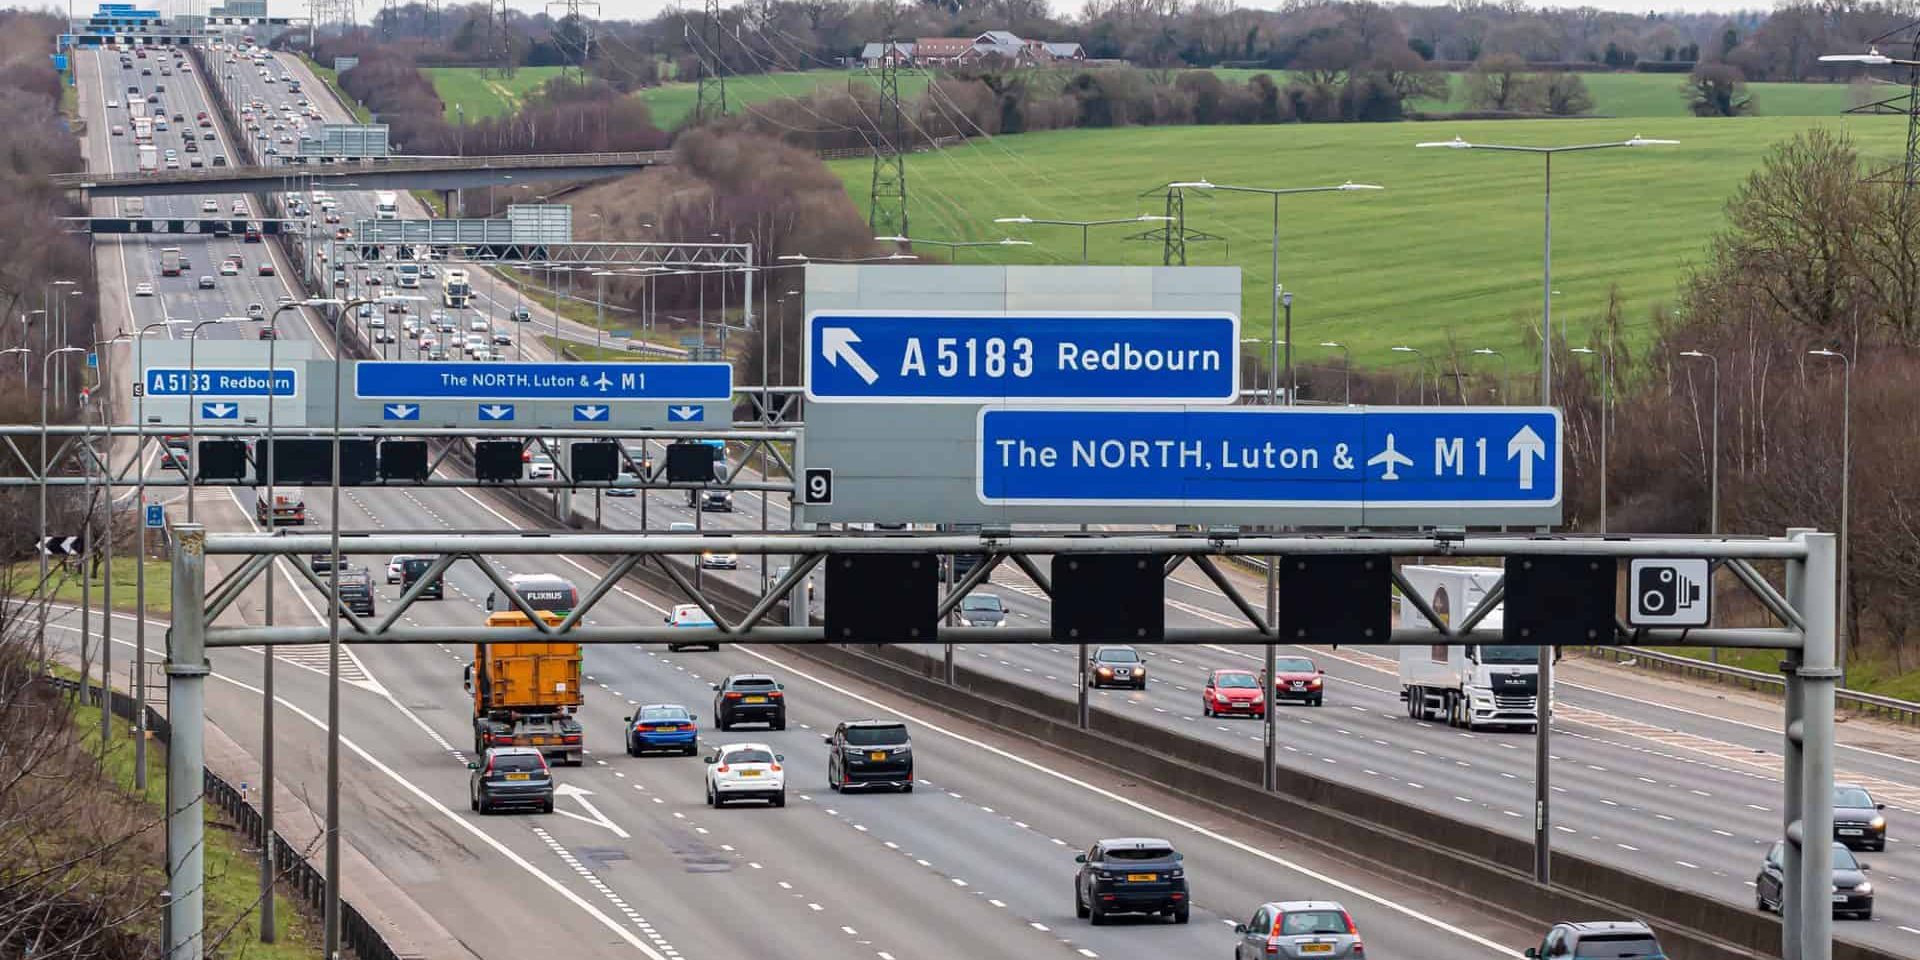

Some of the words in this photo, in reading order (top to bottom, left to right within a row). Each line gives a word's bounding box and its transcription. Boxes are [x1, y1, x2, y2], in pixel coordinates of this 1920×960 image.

[900, 337, 1033, 378] A5183
[1058, 342, 1220, 371] Redbourn
[220, 376, 289, 389] Redbourn
[441, 373, 467, 387] The
[534, 374, 575, 387] Luton
[580, 375, 589, 387] &
[622, 373, 645, 390] M1
[996, 440, 1057, 468] The
[1072, 439, 1211, 470] NORTH,
[1222, 441, 1318, 469] Luton
[1333, 442, 1355, 470] &
[1435, 437, 1487, 476] M1
[811, 475, 827, 498] 9
[527, 591, 563, 601] FLIXBUS
